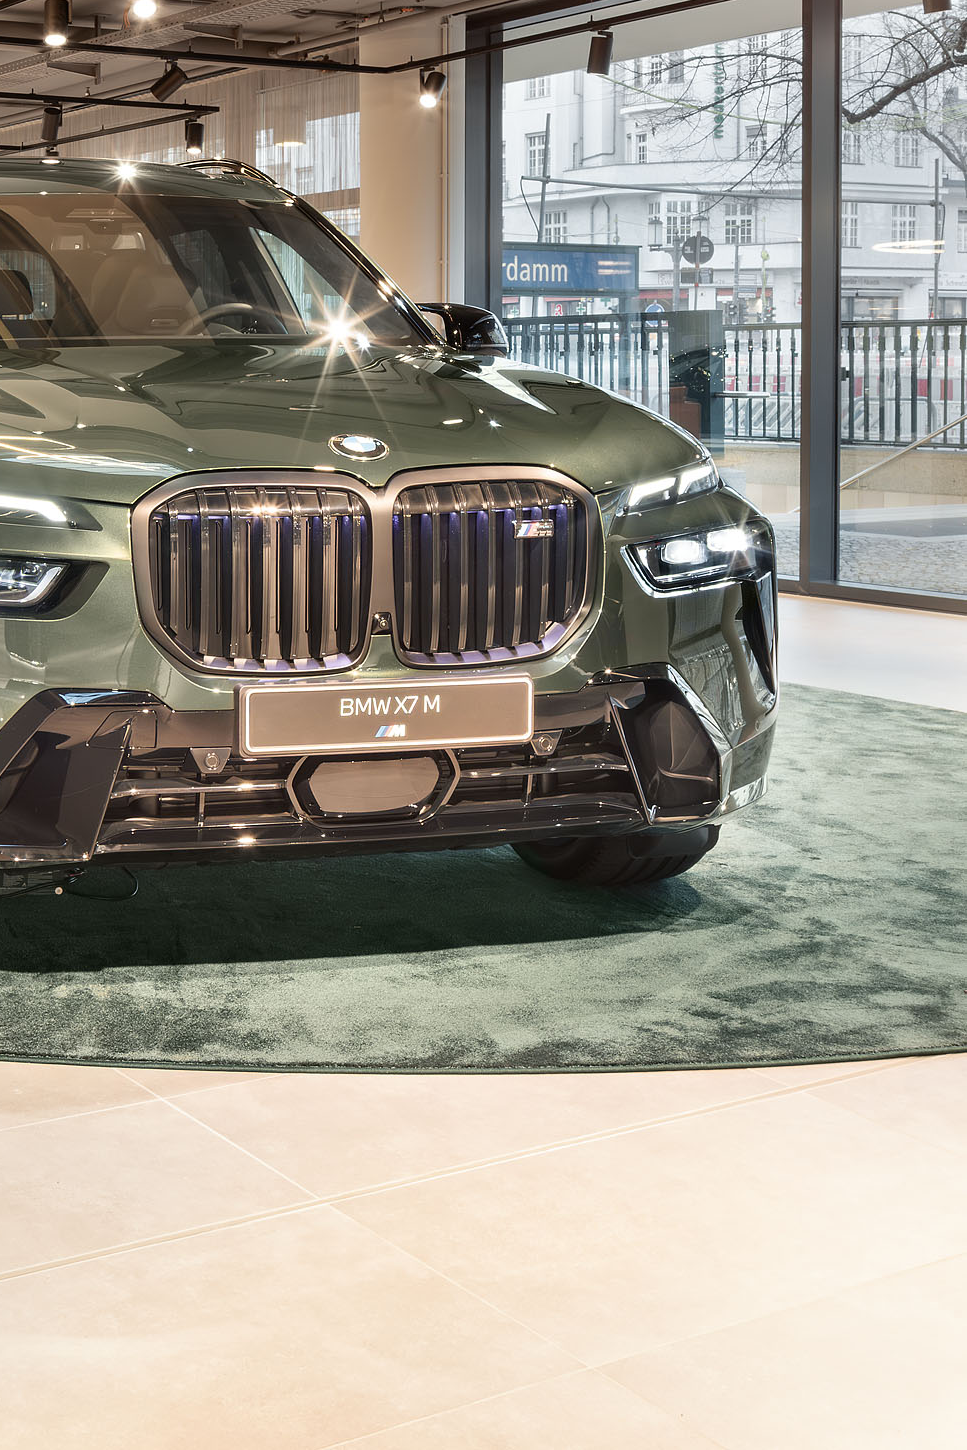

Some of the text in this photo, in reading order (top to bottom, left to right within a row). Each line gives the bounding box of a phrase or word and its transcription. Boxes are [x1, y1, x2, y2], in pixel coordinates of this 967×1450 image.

[340, 695, 440, 716] BMW X7 M
